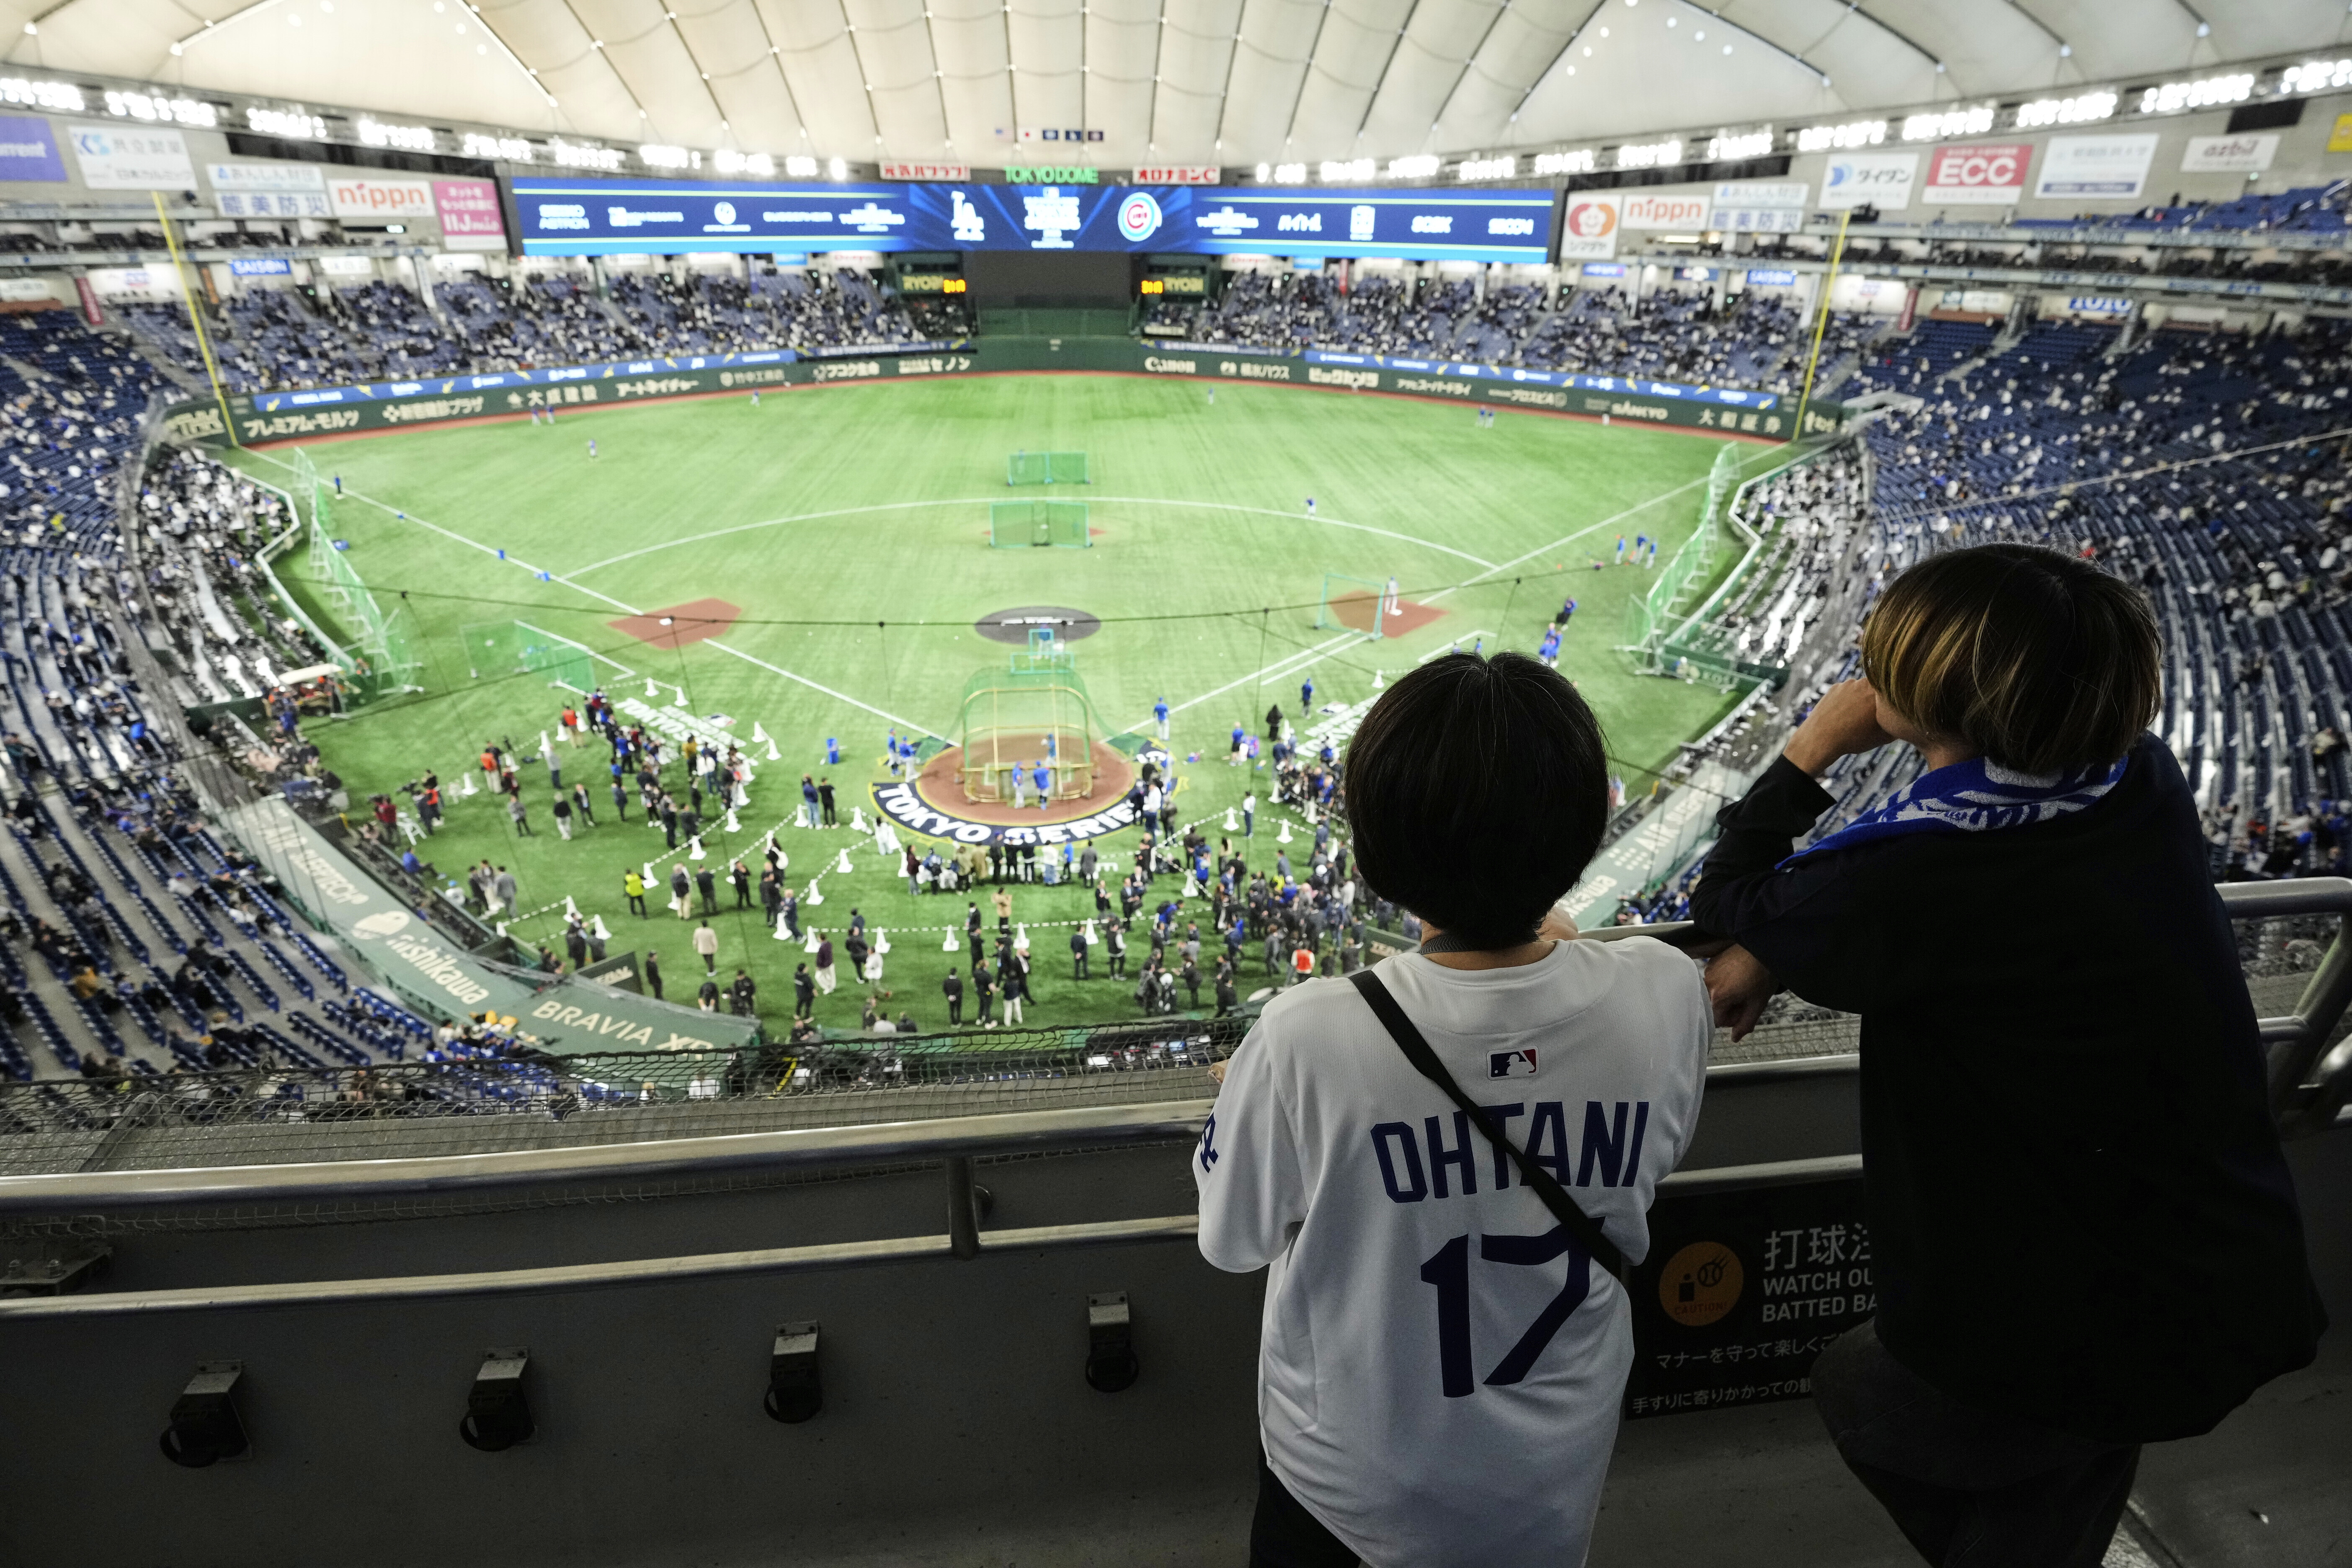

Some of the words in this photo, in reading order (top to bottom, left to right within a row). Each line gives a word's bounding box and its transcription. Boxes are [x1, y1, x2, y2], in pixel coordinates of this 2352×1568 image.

[1005, 166, 1054, 183] TOKYO
[1054, 167, 1099, 183] DOME
[1936, 157, 2017, 185] ECC
[338, 183, 426, 209] nippn
[1629, 199, 1702, 221] nippn
[1144, 356, 1196, 374] Canon
[879, 783, 992, 842] TOKYO
[1003, 798, 1136, 846] SERIE
[531, 1001, 653, 1046] BRAVIA
[1370, 1101, 1650, 1204] OHTANI
[1763, 1273, 1841, 1297] WATCH
[1848, 1268, 1873, 1287] OU
[1420, 1215, 1607, 1398] 17
[1762, 1297, 1846, 1323] BATTED
[1853, 1292, 1877, 1313] BA
[1656, 1333, 1843, 1369] マナーを守って楽しくご
[1632, 1377, 1811, 1413] 手すりに寄りかかっての観
